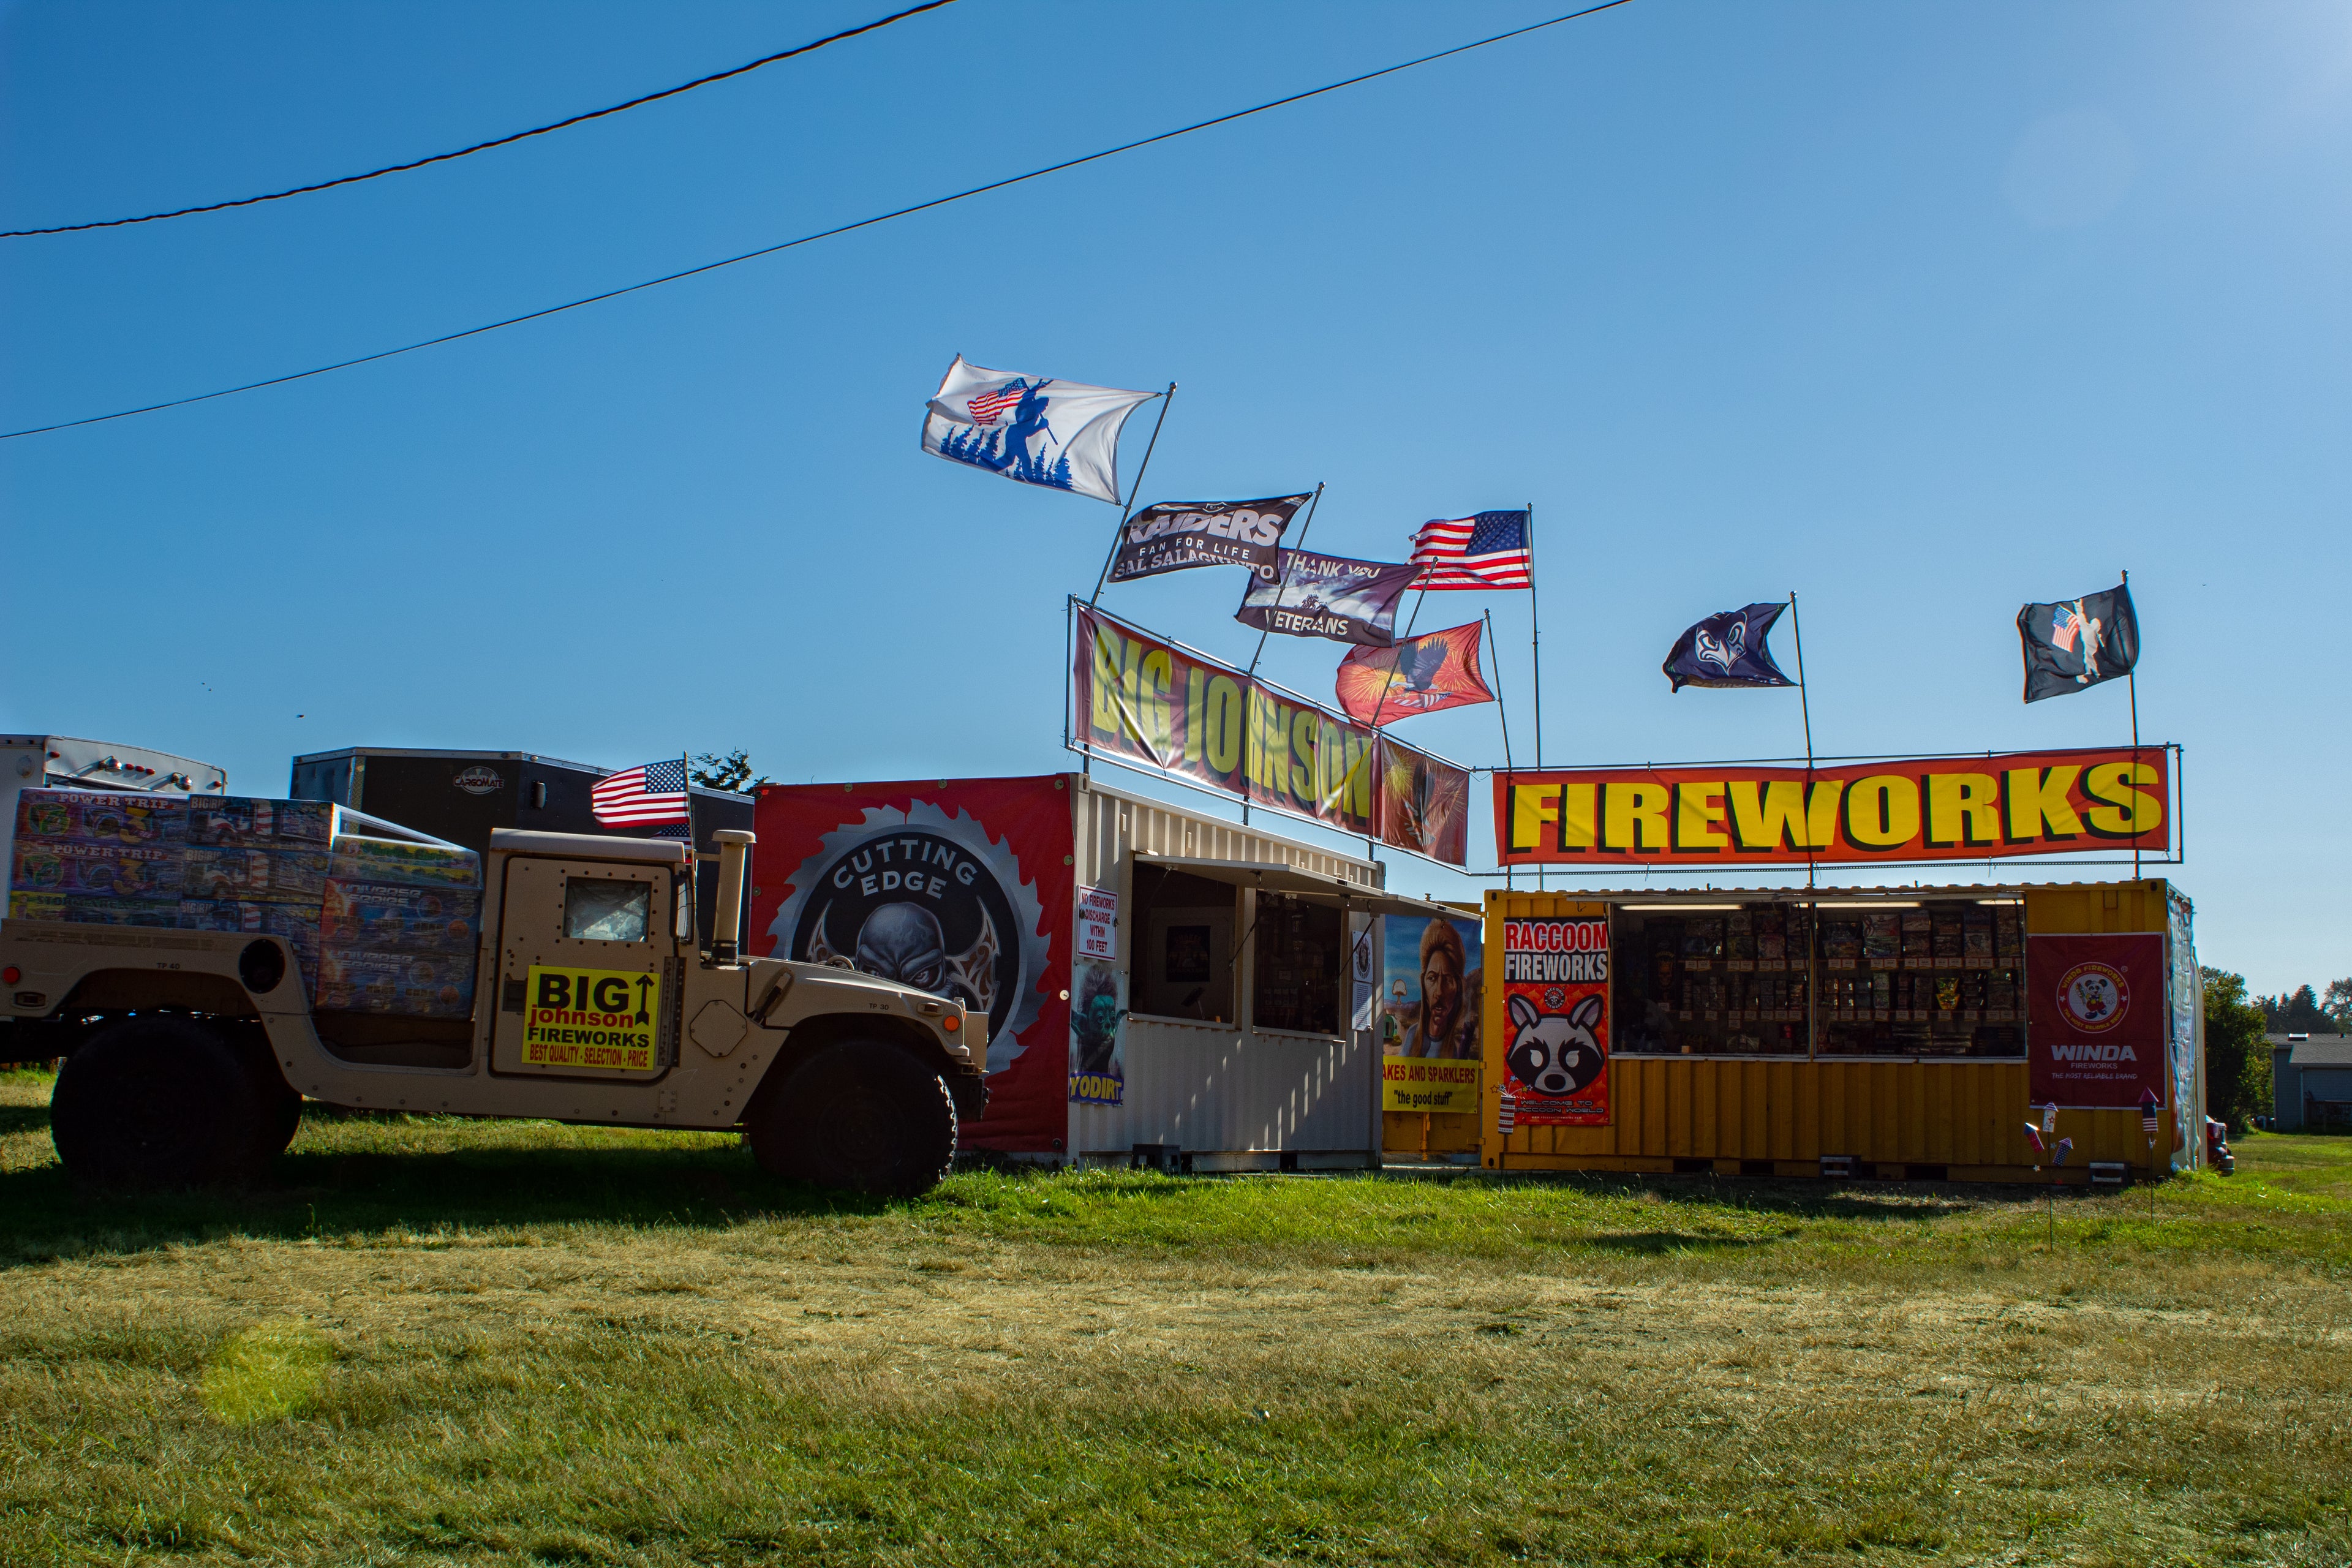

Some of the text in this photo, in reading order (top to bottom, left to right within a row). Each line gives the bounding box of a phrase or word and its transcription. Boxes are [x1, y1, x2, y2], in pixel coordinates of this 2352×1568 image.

[1126, 508, 1284, 547] RAIDERS
[1139, 537, 1250, 559] FAN FOR LIFE
[1114, 558, 1147, 578] SAL
[1286, 552, 1382, 579] THANK YOU
[1265, 609, 1349, 636] VETERANS
[1090, 624, 1373, 821] BIG JOHNSON
[58, 793, 121, 807] POWER
[124, 797, 170, 809] TRIP
[190, 797, 209, 809] BIG
[1510, 761, 2162, 851] FIREWORKS
[53, 844, 115, 857] POWER
[118, 848, 163, 861] TRIP
[186, 849, 204, 861] BIG
[833, 839, 979, 889] CUTTING
[337, 884, 423, 898] UNIVERSE
[860, 870, 948, 900] EDGE
[181, 902, 196, 913] BIG
[347, 894, 409, 907] SERIES
[1082, 892, 1115, 911] NO FIREWORKS
[1085, 908, 1110, 925] DISCHARGE
[1090, 924, 1105, 938] WITHIN
[1504, 924, 1608, 950] RACCOON
[1087, 938, 1107, 953] 100 FEET
[330, 949, 413, 964] UNIVERSE
[1505, 953, 1608, 981] FIREWORKS
[2084, 965, 2125, 987] FIREWORKS
[538, 973, 630, 1013] BIG
[528, 1005, 633, 1028] johnson
[2070, 1016, 2084, 1028] MOST
[527, 1027, 649, 1047] FIREWORKS
[529, 1044, 648, 1067] BEST QUALITY SELECTION PRICE
[2051, 1045, 2137, 1061] WINDA
[1408, 1065, 1426, 1081] AND
[1428, 1066, 1476, 1084] SPARKLERS
[1070, 1076, 1121, 1100] YODIRT
[1394, 1090, 1453, 1108] "the good stuff"
